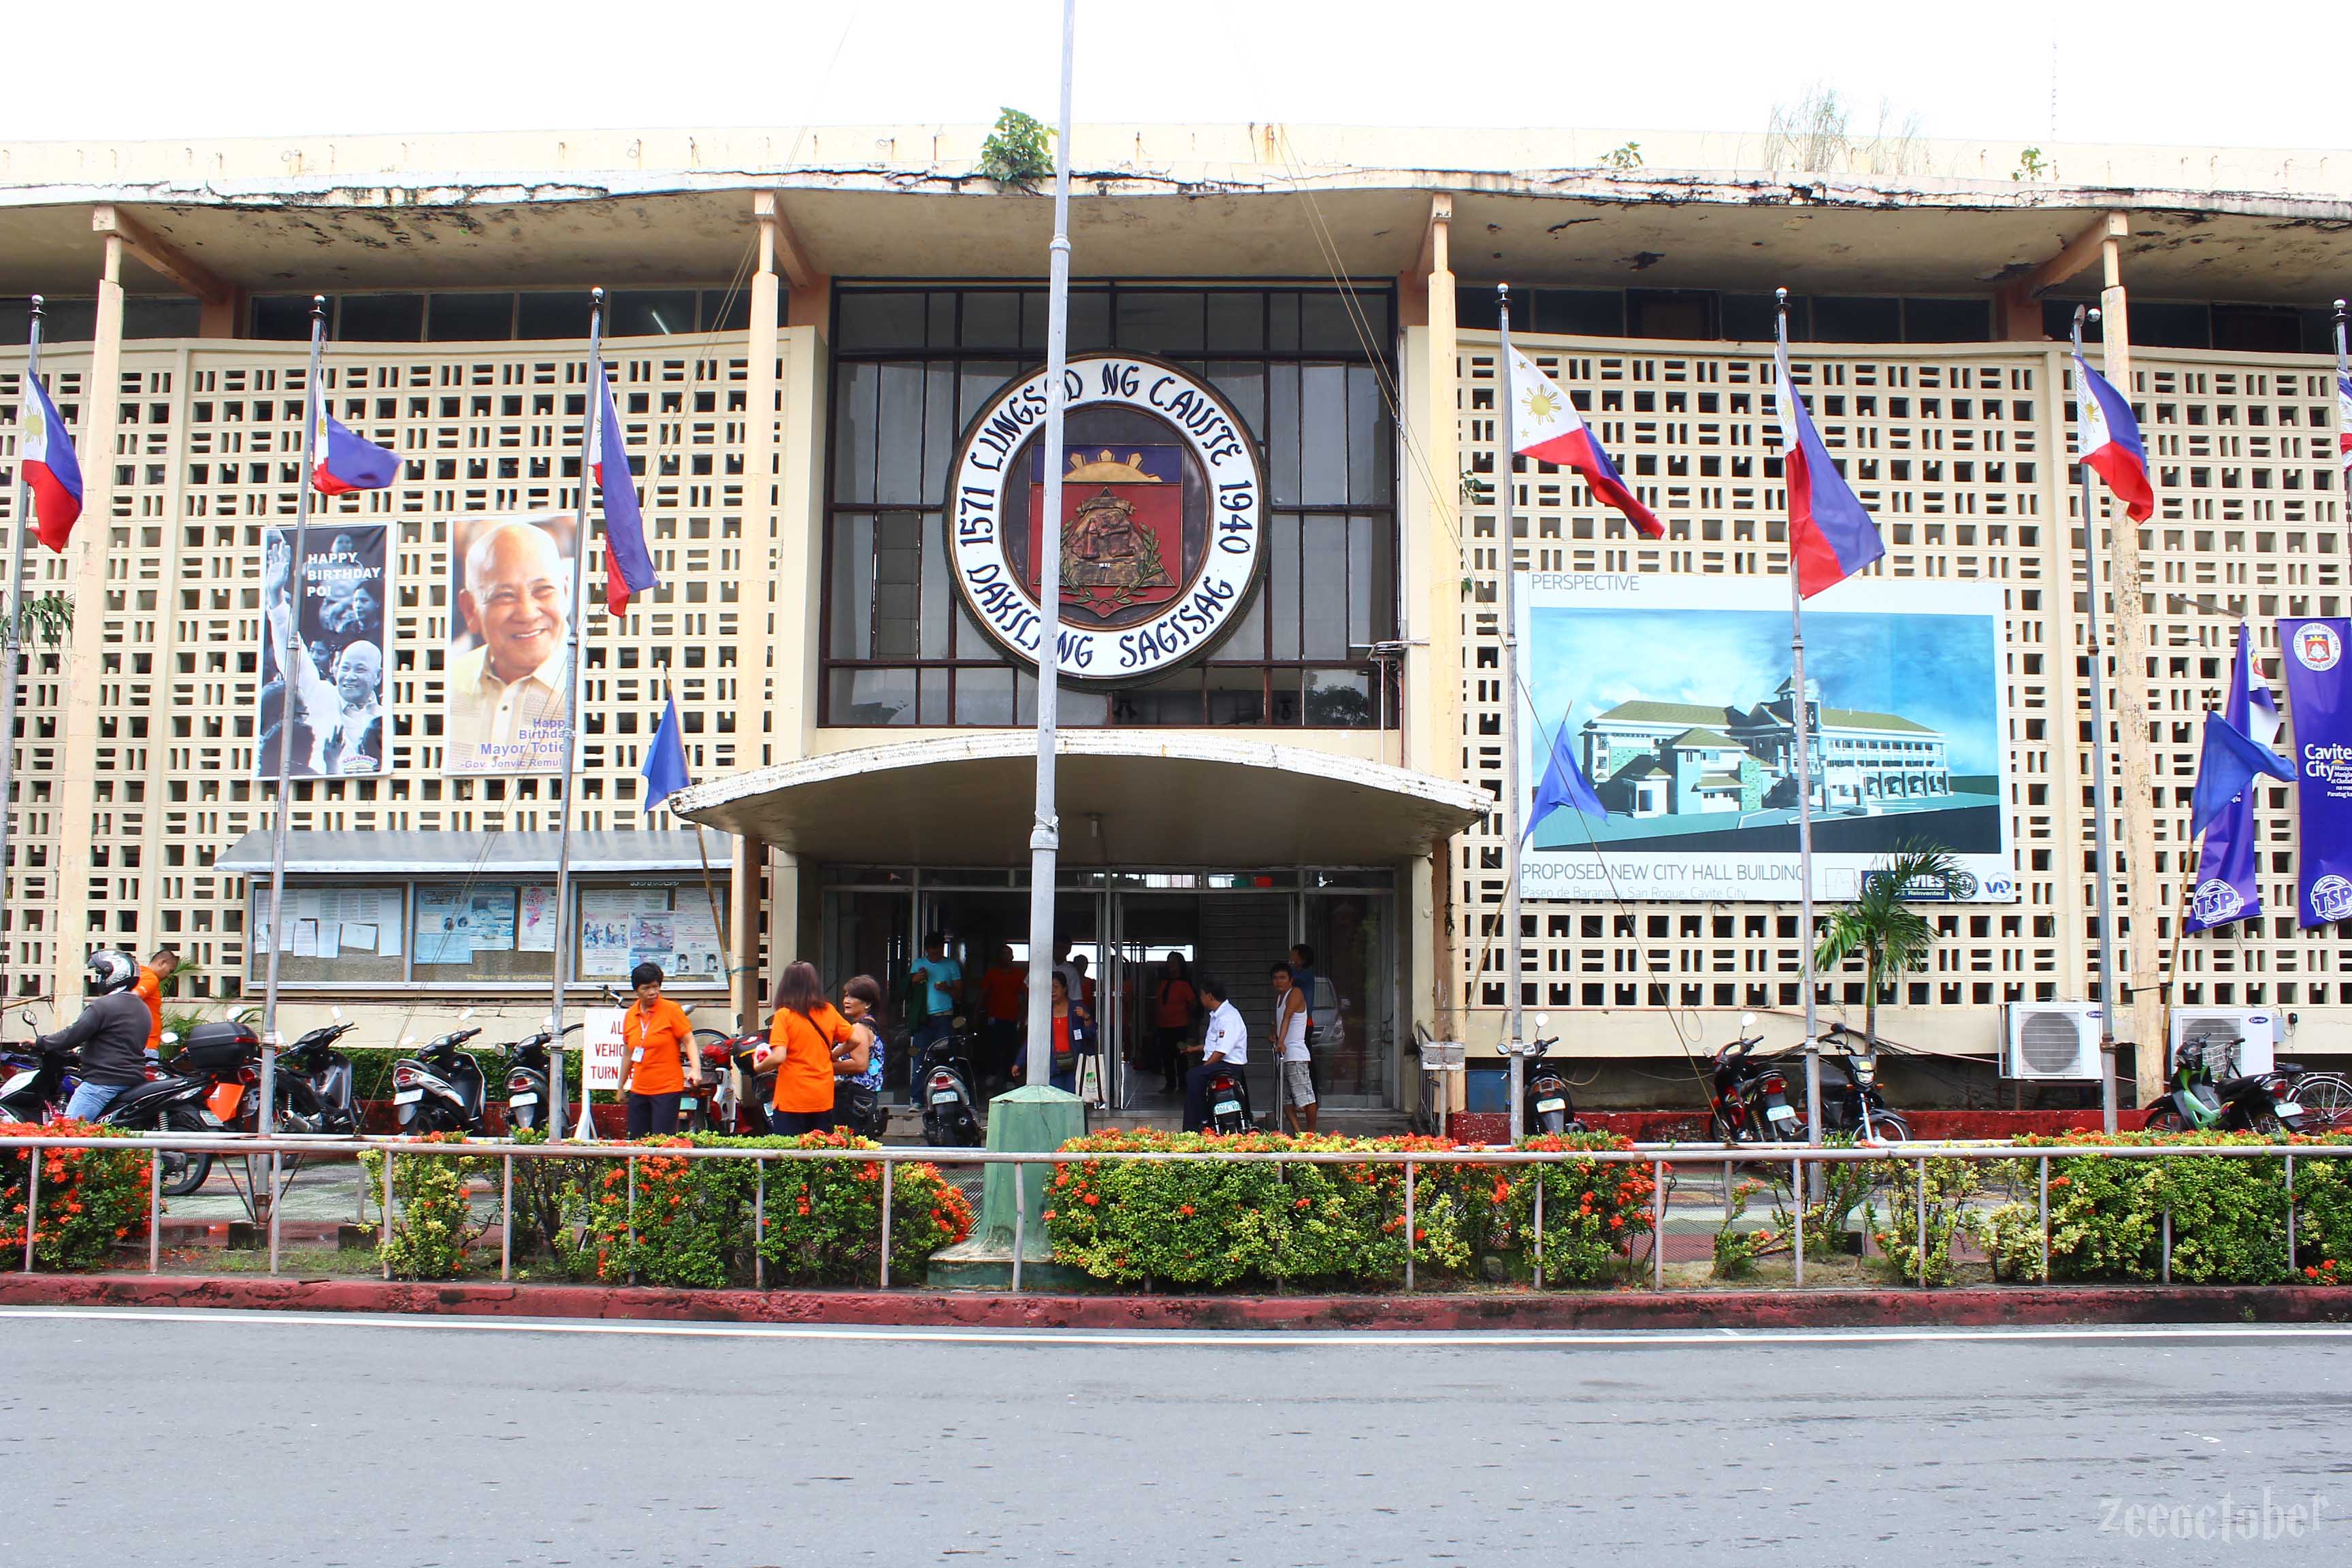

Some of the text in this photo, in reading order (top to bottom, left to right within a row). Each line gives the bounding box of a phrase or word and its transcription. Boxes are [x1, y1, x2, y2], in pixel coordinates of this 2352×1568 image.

[1102, 363, 1139, 396] NG
[969, 368, 1083, 472] LUNGSD
[960, 486, 995, 547] 1571
[1218, 480, 1253, 554] 1940
[308, 552, 358, 564] HAPPY
[308, 567, 381, 580] BIRTHDAY
[1532, 574, 1639, 591] PERSPECTIVE
[307, 585, 331, 597] PO!
[1120, 576, 1234, 667] SAGISAG
[534, 719, 564, 729] Happ
[519, 730, 564, 739] Birthda
[481, 742, 525, 757] Mayor
[2304, 743, 2352, 760] Cavite
[491, 760, 526, 768] Jonvic
[531, 759, 562, 767] Remul
[2306, 760, 2335, 781] City
[1522, 864, 1605, 879] PROPOSED
[1612, 864, 1648, 879] NEW
[1654, 864, 1687, 880] CITY
[1693, 865, 1732, 880] HALL
[1892, 875, 1944, 887] VIES
[1522, 886, 1553, 897] Paseo
[1557, 887, 1569, 898] de
[1628, 887, 1648, 898] San
[1690, 887, 1722, 898] Cavite
[1727, 887, 1747, 899] City
[2313, 886, 2352, 913] TSP
[2195, 891, 2234, 917] TSP
[610, 1021, 623, 1034] AL
[595, 1044, 624, 1057] VEHIC
[591, 1066, 618, 1079] TURN
